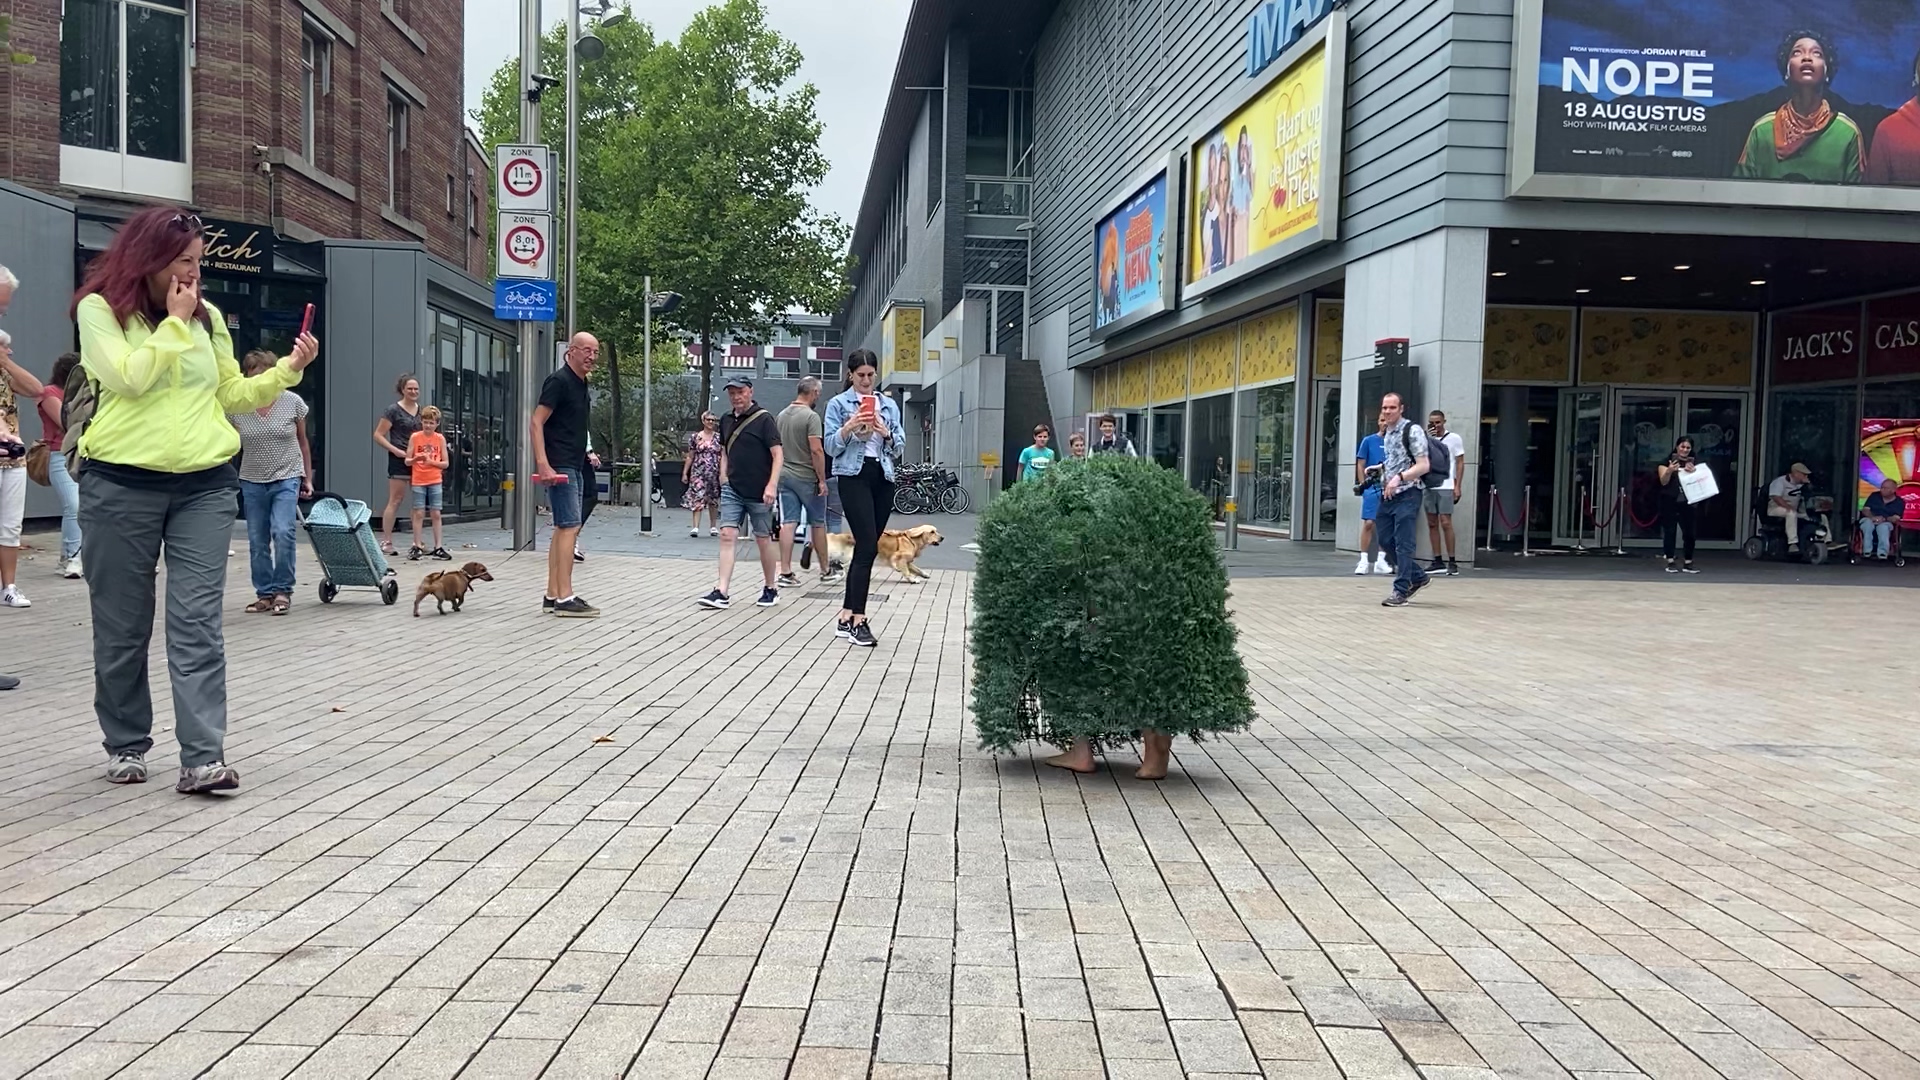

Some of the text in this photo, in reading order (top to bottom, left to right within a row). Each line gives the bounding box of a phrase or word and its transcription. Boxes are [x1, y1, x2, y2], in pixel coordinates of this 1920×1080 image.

[1641, 48, 1677, 56] JORDAN
[1562, 57, 1714, 97] NOPE
[1564, 102, 1706, 122] 18 AUGUSTUS
[1275, 104, 1321, 151] Hart op
[1563, 120, 1584, 128] SHOT
[1586, 121, 1607, 129] WITH
[1608, 121, 1648, 132] IMAX
[1669, 124, 1707, 133] CAMERAS
[510, 149, 533, 157] ZONE
[514, 167, 532, 179] 11m
[1286, 167, 1319, 214] Plek
[513, 216, 536, 224] ZONE
[203, 224, 262, 260] tch
[214, 262, 261, 273] RESTAURANT
[1782, 320, 1920, 360] JACK'S CAS
